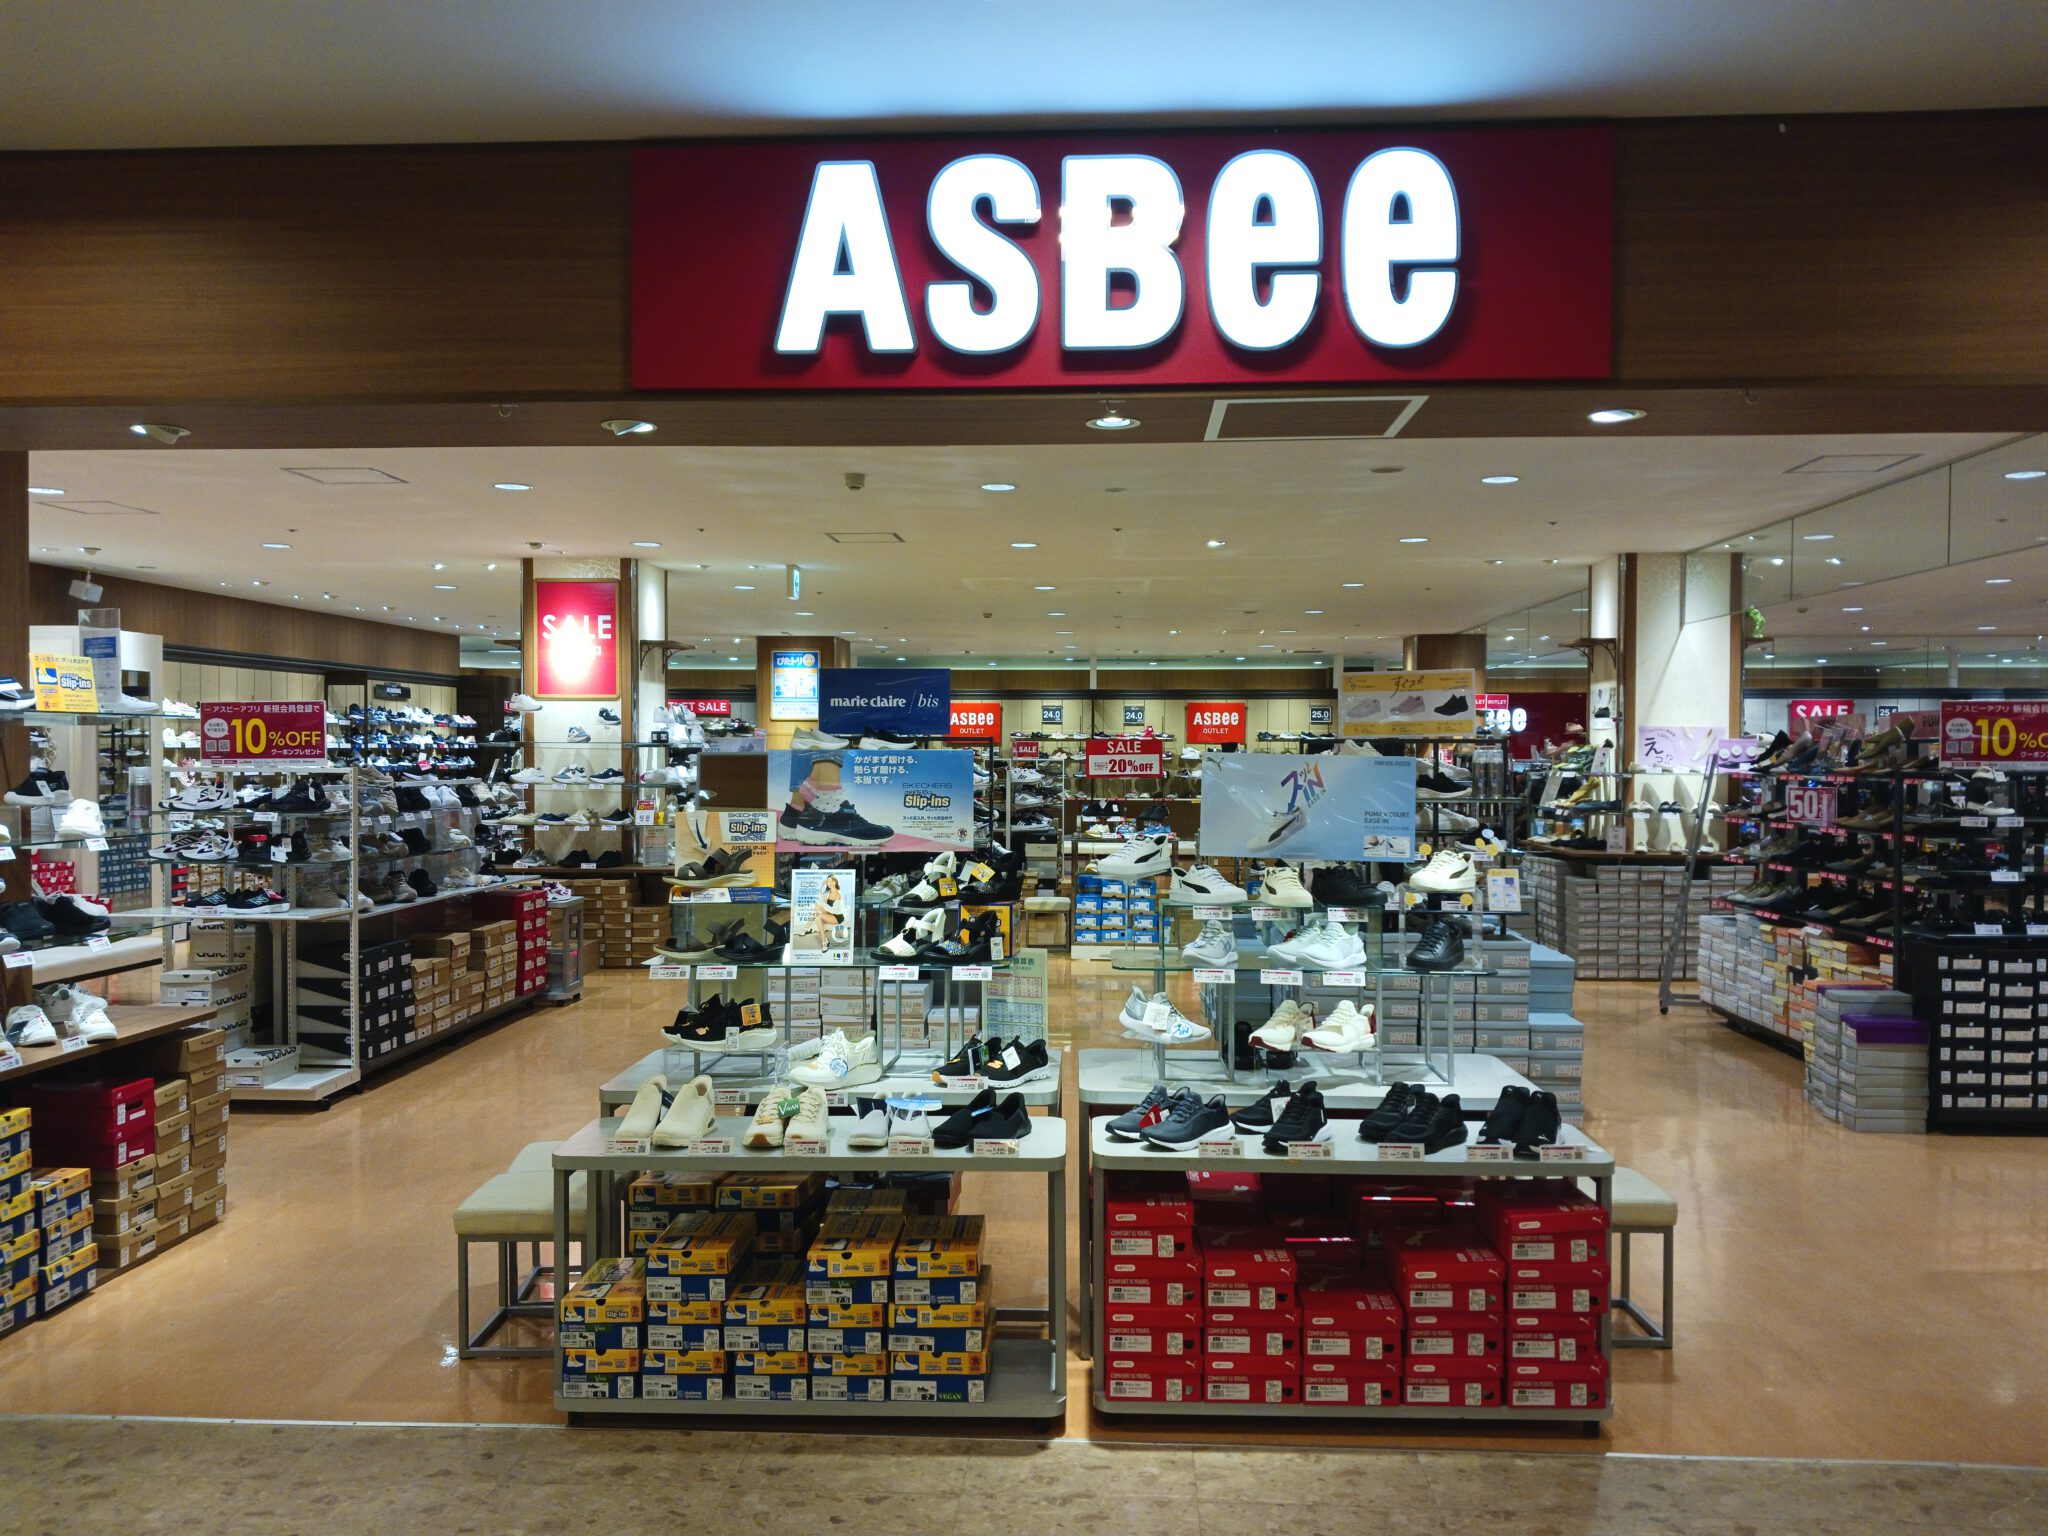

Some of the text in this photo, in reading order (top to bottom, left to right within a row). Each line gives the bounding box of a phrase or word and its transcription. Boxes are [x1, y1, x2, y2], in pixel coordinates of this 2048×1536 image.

[776, 150, 1458, 352] ASBee
[698, 702, 727, 711] SALE
[830, 694, 939, 707] marie claire bis
[950, 712, 994, 726] ASBee
[1125, 711, 1143, 719] 24.0
[1193, 712, 1239, 726] ASBee
[1311, 710, 1329, 719] 25.0
[1106, 741, 1142, 753] SALE
